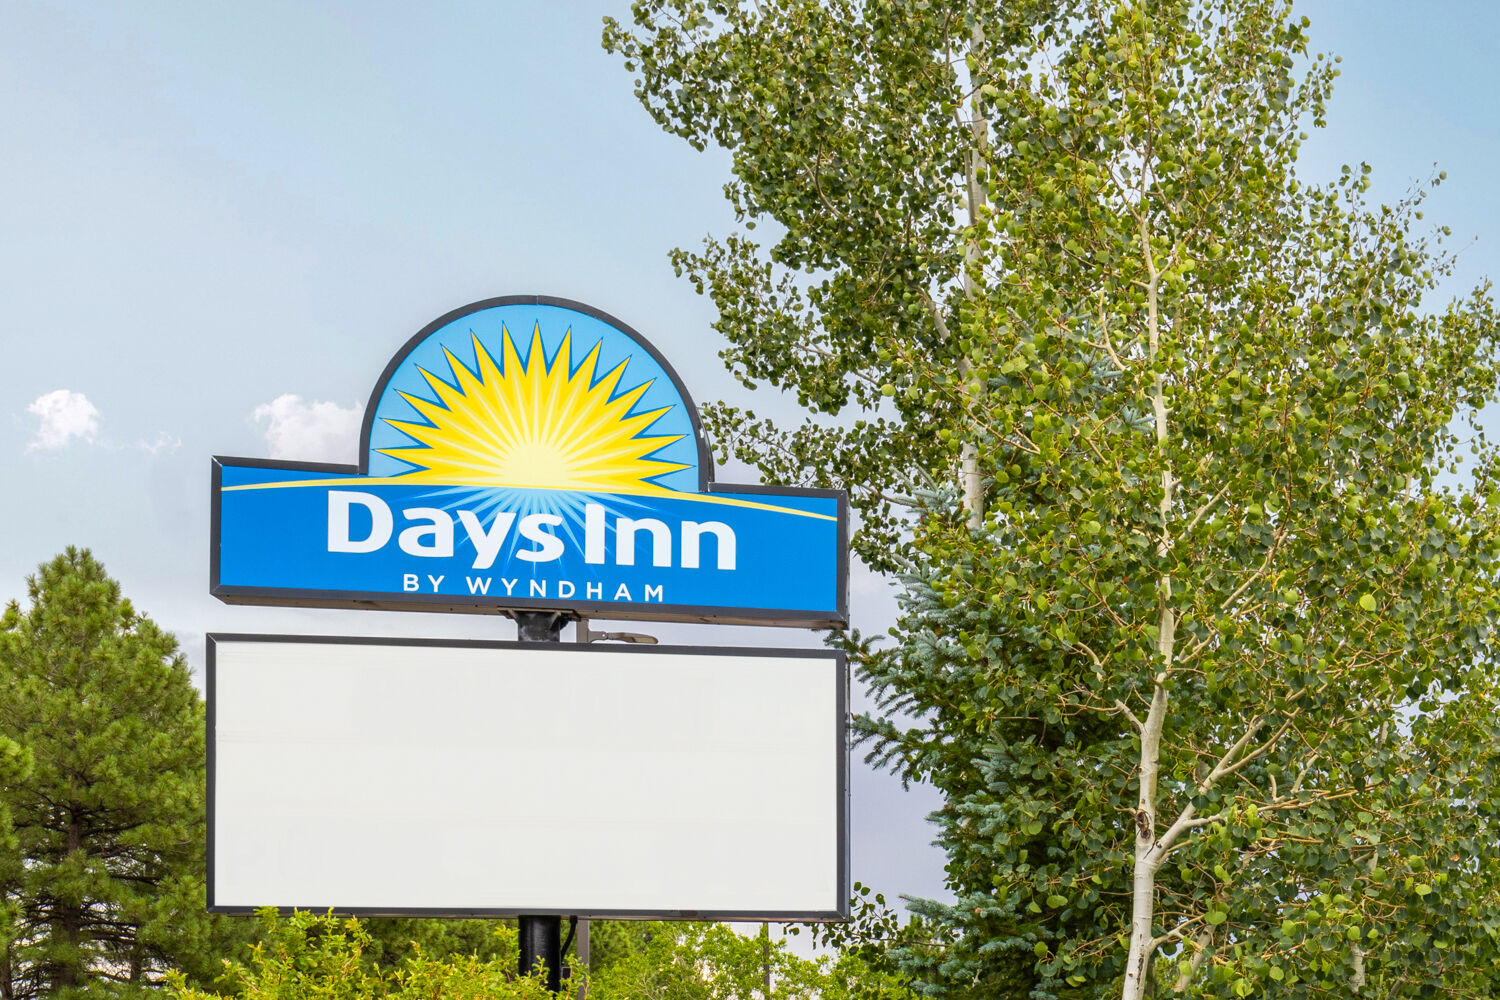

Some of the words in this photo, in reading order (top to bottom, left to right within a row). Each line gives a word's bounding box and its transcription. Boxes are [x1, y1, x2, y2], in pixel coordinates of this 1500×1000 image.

[327, 490, 565, 570] Days
[584, 503, 737, 571] Inn
[403, 573, 446, 593] BY
[465, 576, 664, 603] WYNDHAM
